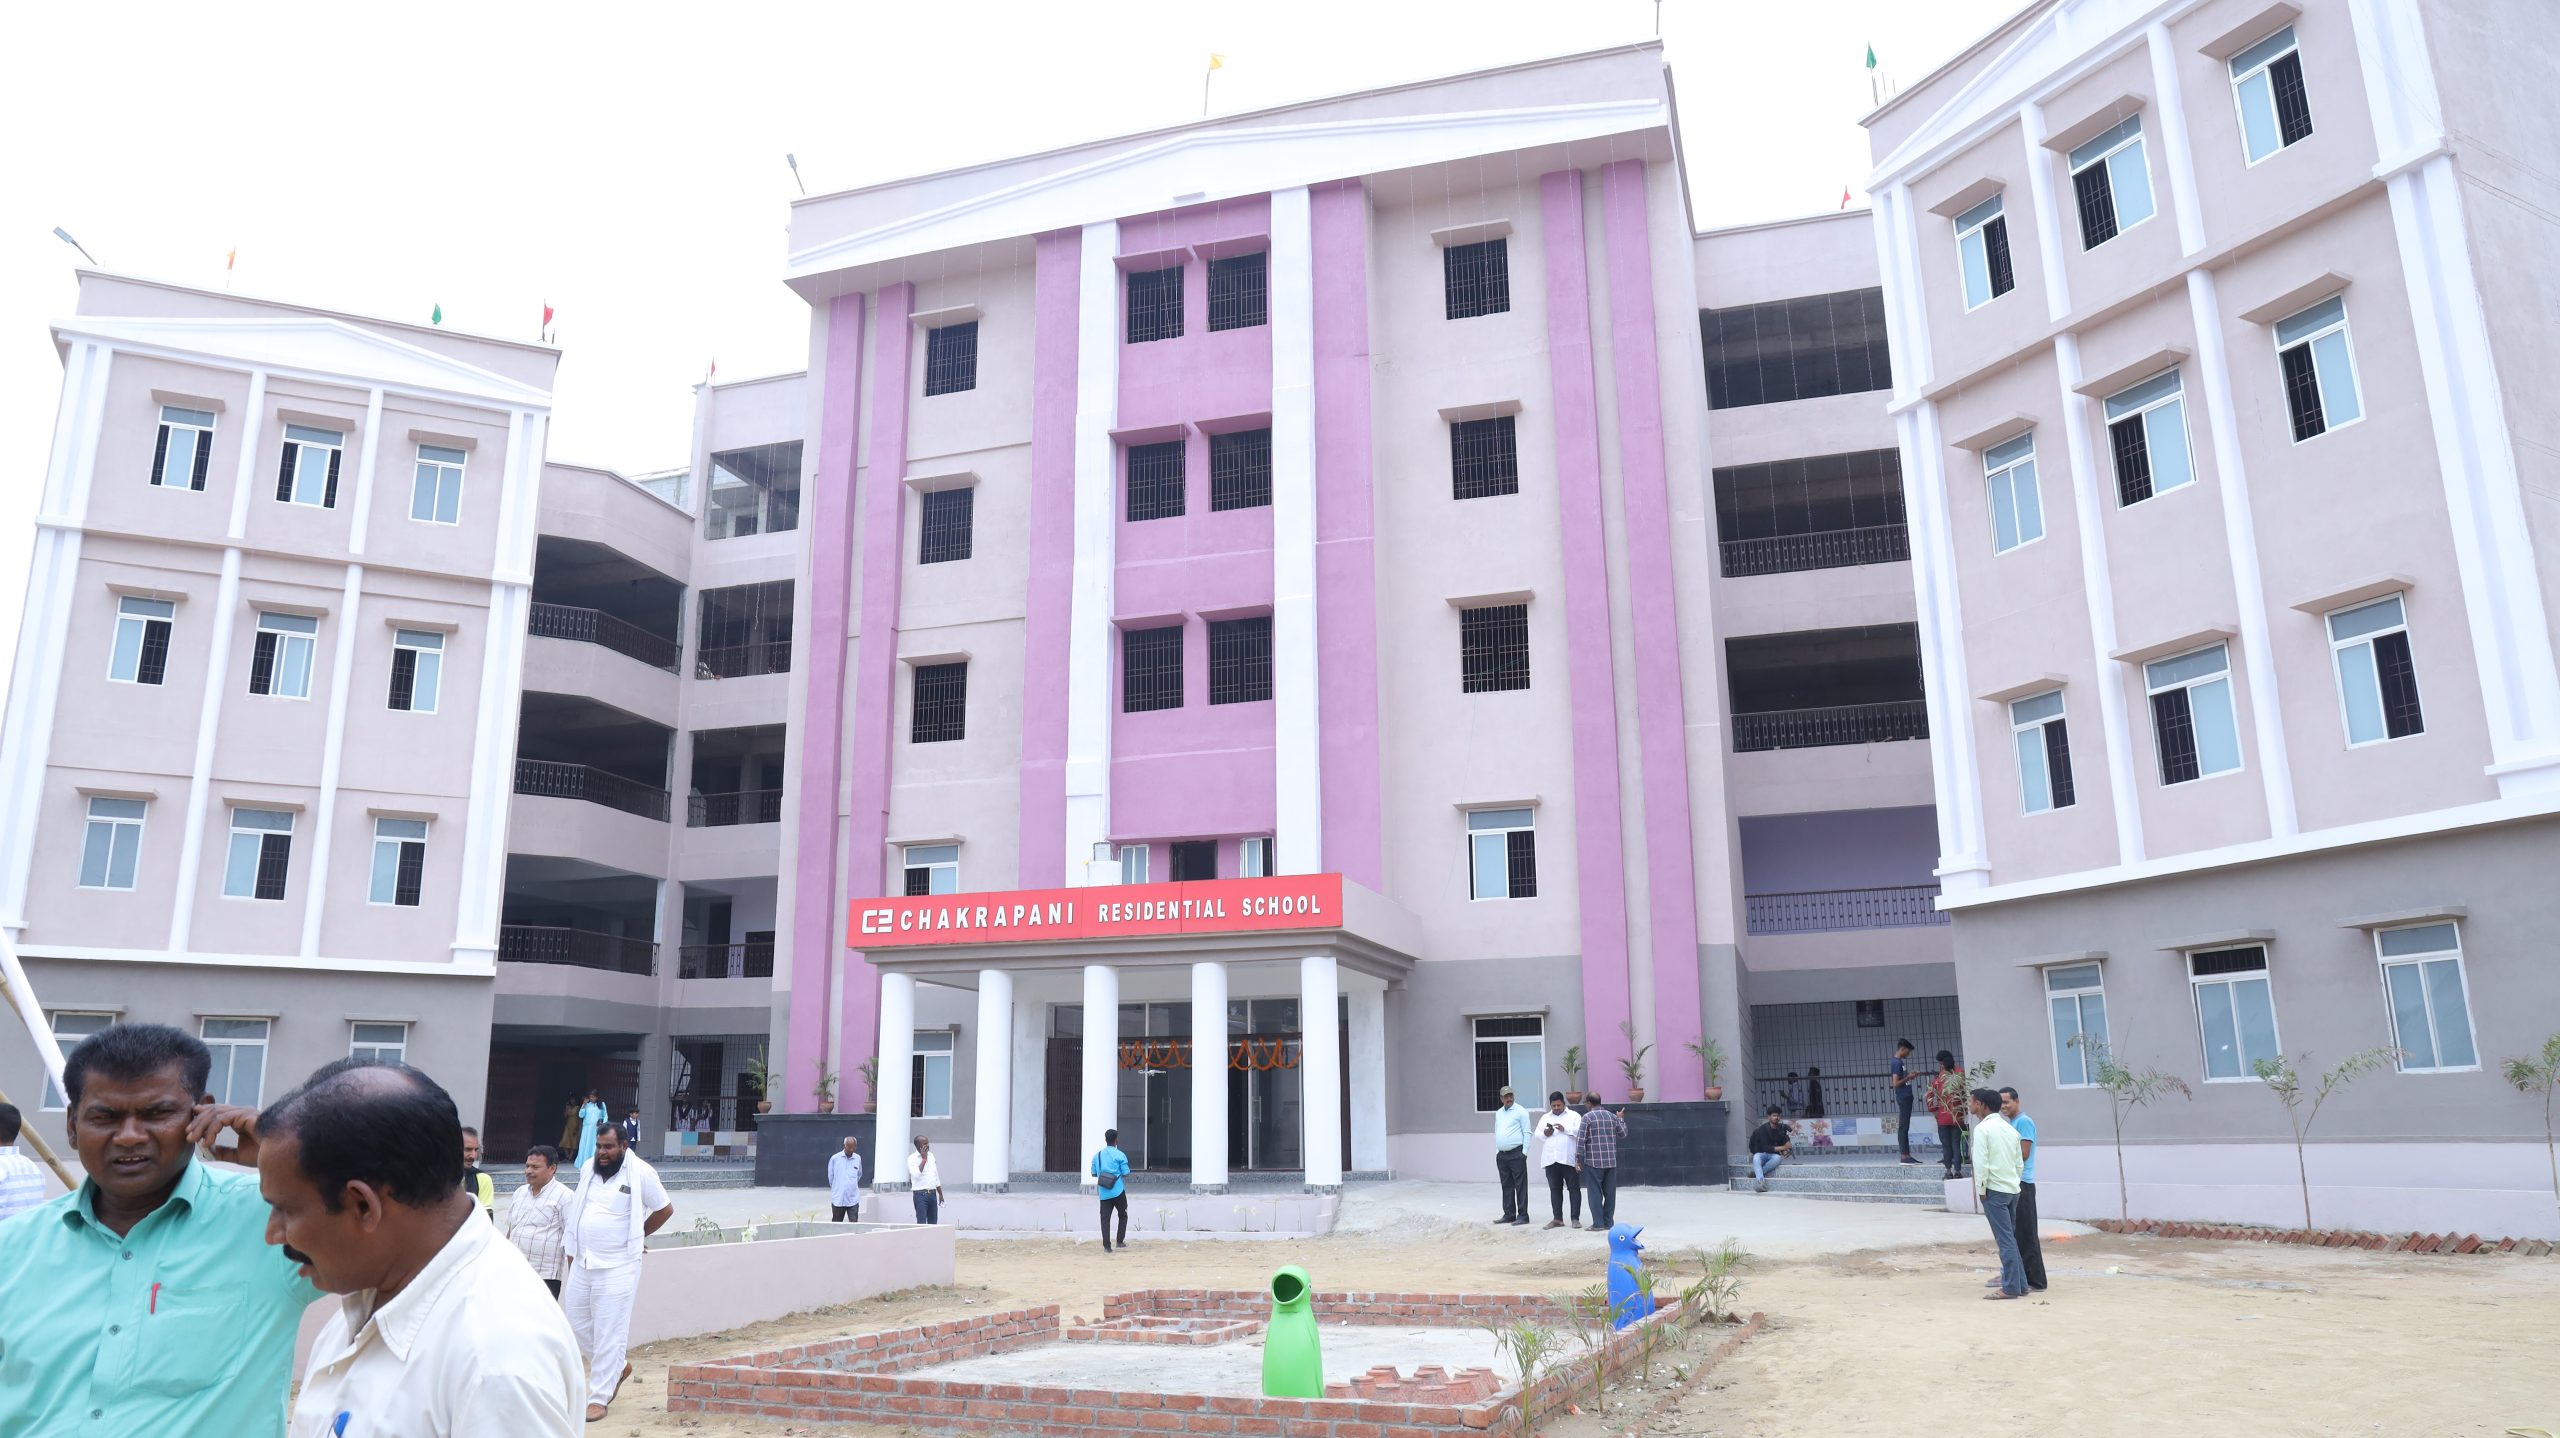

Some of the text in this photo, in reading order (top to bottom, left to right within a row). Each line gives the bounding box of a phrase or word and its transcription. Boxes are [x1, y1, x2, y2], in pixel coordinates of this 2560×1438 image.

[900, 894, 1321, 931] CHAKRAPANI RESIDENTIAL SCHOOL
